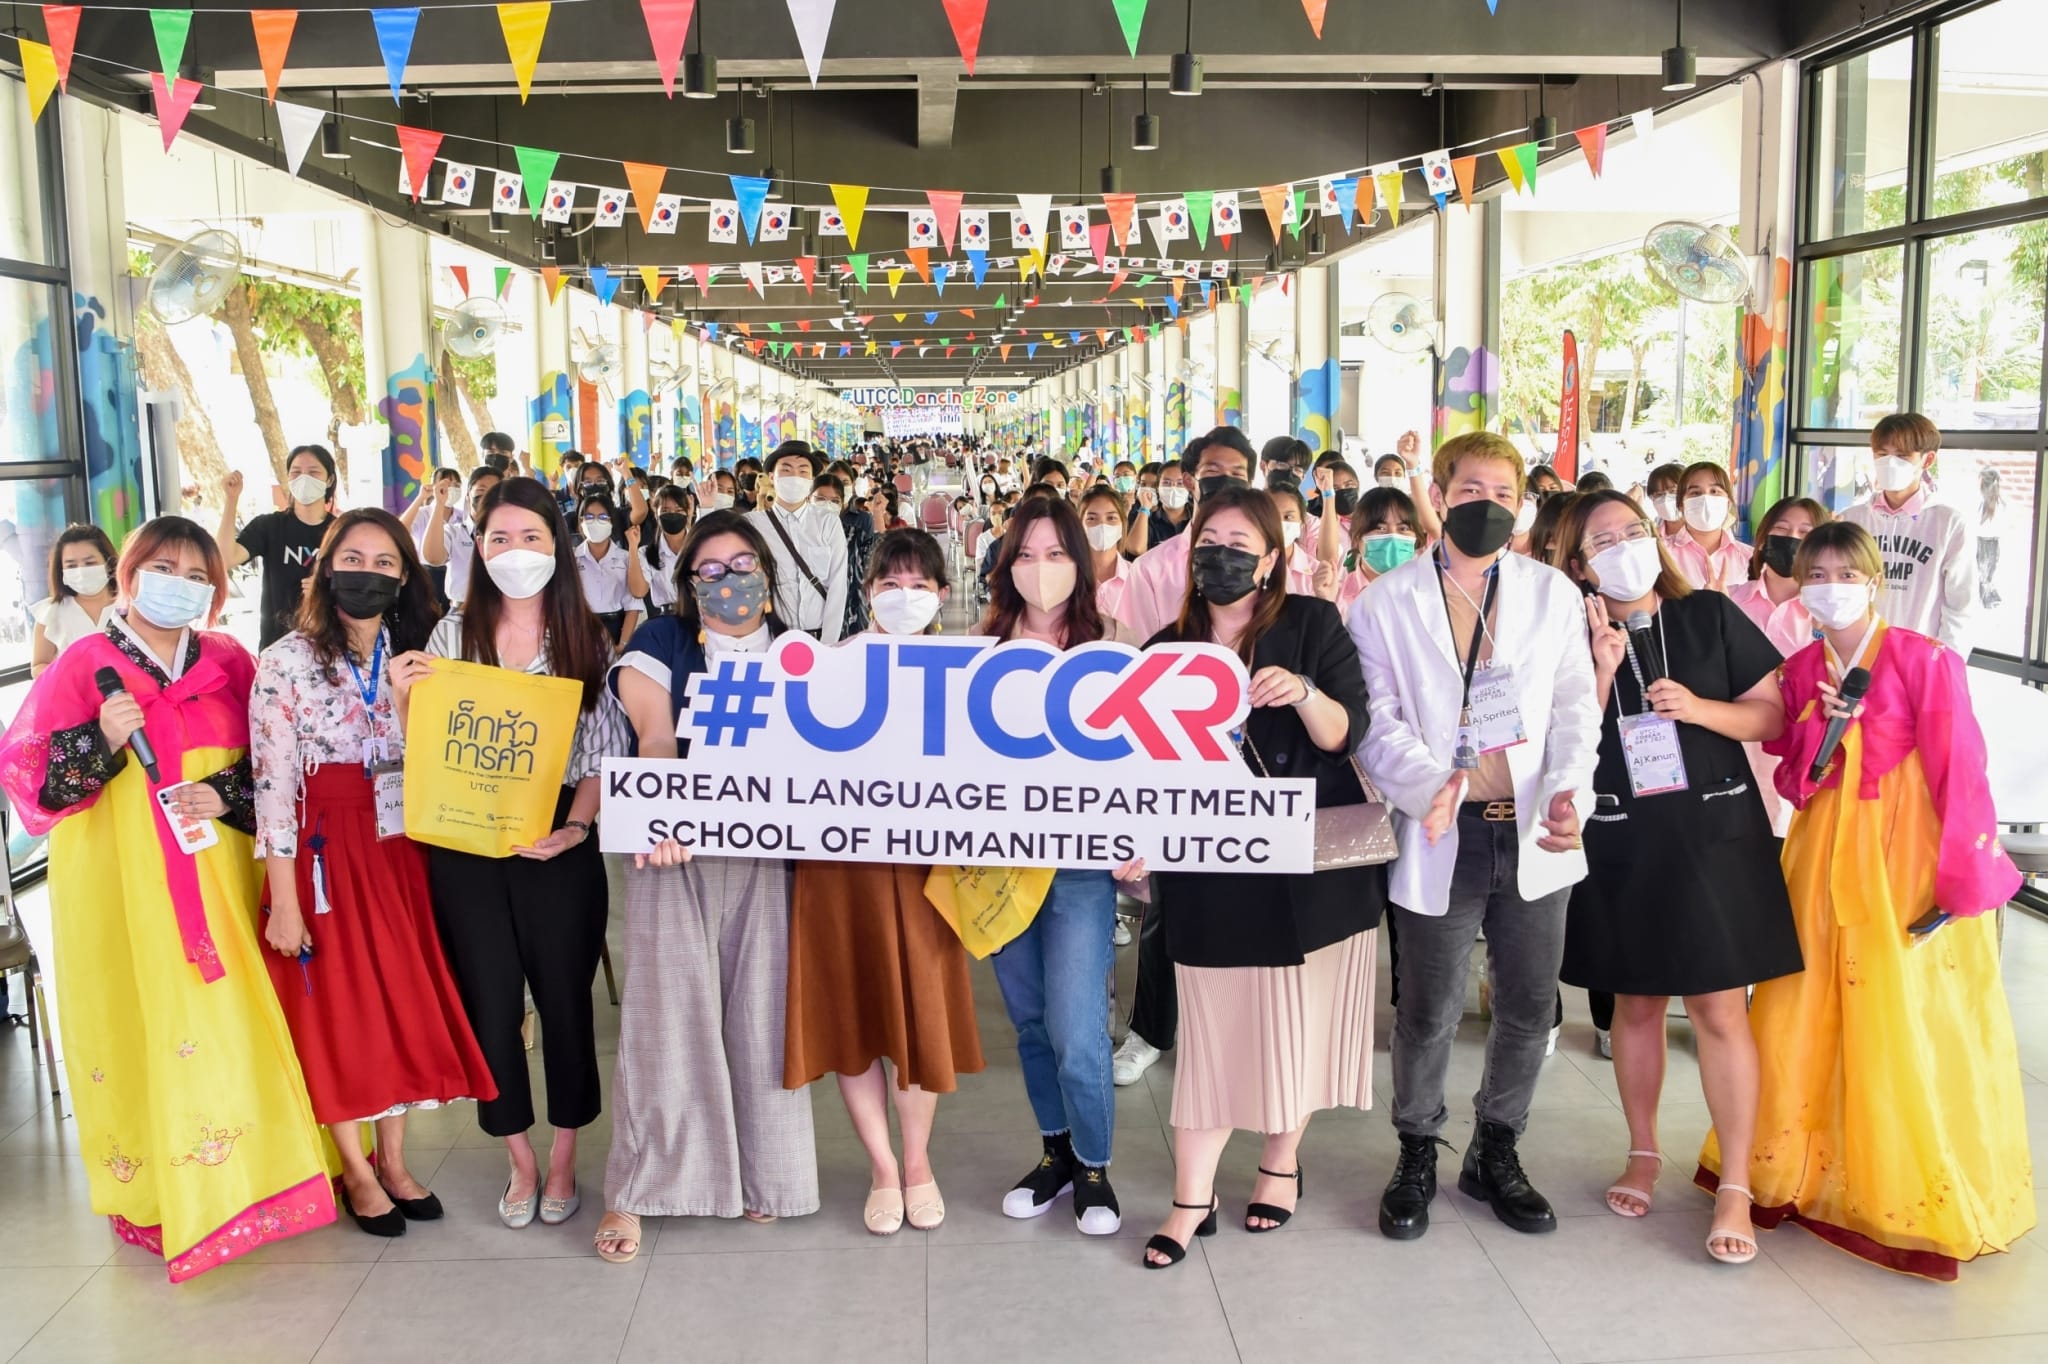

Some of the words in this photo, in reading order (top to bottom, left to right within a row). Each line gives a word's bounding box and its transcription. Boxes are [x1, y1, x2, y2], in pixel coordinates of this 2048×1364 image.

[1883, 562, 1914, 580] AMP
[447, 699, 538, 747] เด็กหัว
[445, 739, 534, 774] การค้า
[470, 780, 500, 793] UTCC
[610, 770, 771, 803] KOREAN
[787, 777, 1006, 811] LANGUAGE
[1024, 785, 1311, 822] DEPARTMENT,
[647, 818, 806, 852] SCHOOL
[820, 826, 872, 854] OF
[1162, 835, 1271, 864] UTCC
